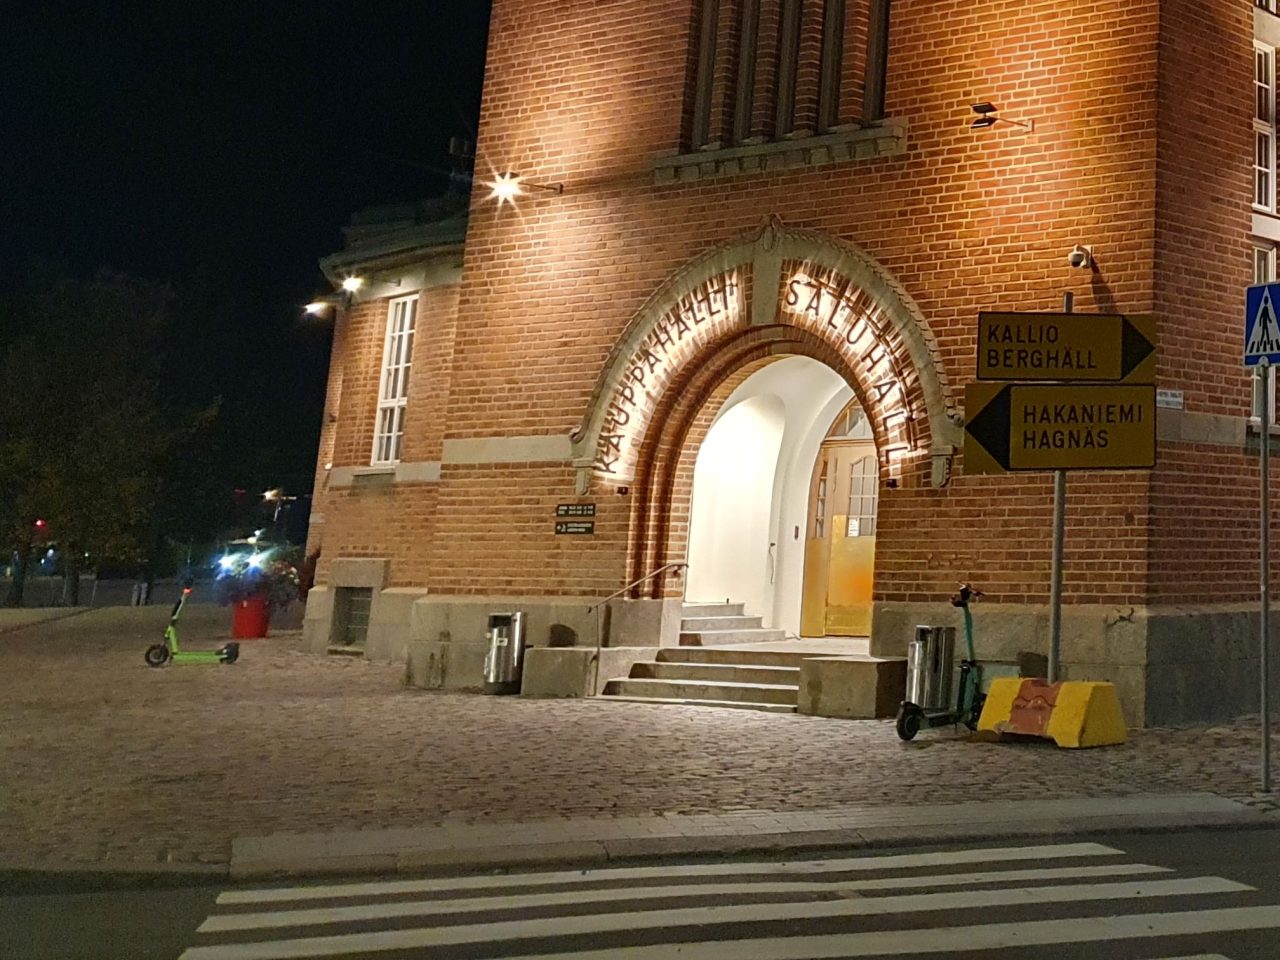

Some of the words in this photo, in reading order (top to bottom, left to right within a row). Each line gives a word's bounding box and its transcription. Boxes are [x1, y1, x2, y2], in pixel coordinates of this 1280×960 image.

[988, 324, 1059, 344] KALLIO
[987, 346, 1097, 369] BERGHÄLL
[596, 286, 732, 474] KAUPPAHALLI
[786, 279, 910, 464] SALUHALL
[1023, 403, 1143, 425] HAKANIEMI
[1023, 426, 1109, 450] HAGNÄS
